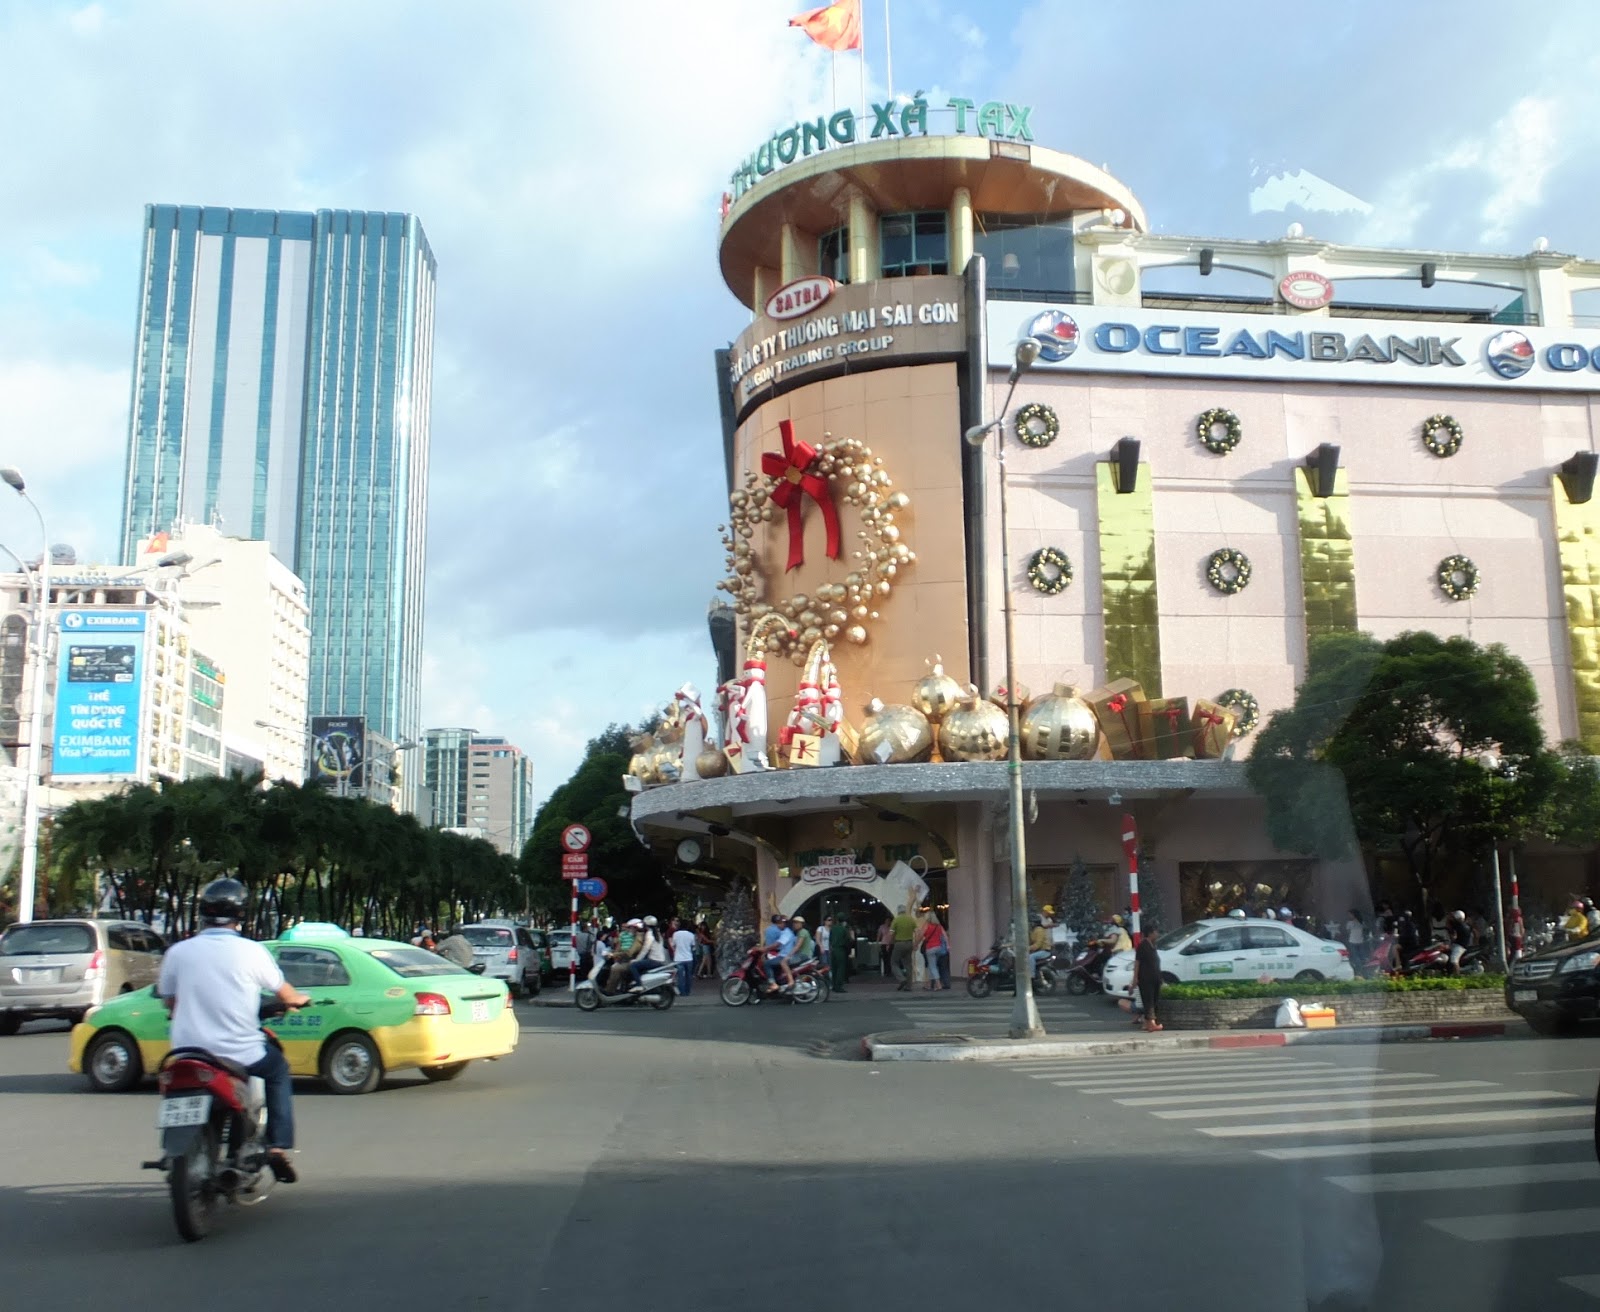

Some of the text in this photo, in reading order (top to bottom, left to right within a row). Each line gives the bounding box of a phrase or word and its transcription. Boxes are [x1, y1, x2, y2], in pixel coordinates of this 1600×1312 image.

[946, 97, 1034, 141] TAX
[775, 283, 822, 313] SATRA
[761, 335, 776, 359] TY
[842, 308, 876, 333] MẠI
[1093, 321, 1466, 366] OCEANBANK
[775, 346, 833, 374] TRADING
[837, 335, 894, 357] GROUP
[86, 616, 139, 625] EXIMBANK
[60, 735, 131, 746] EXIMBANK
[808, 865, 867, 877] CHRISTMAS
[819, 856, 855, 866] MERRY
